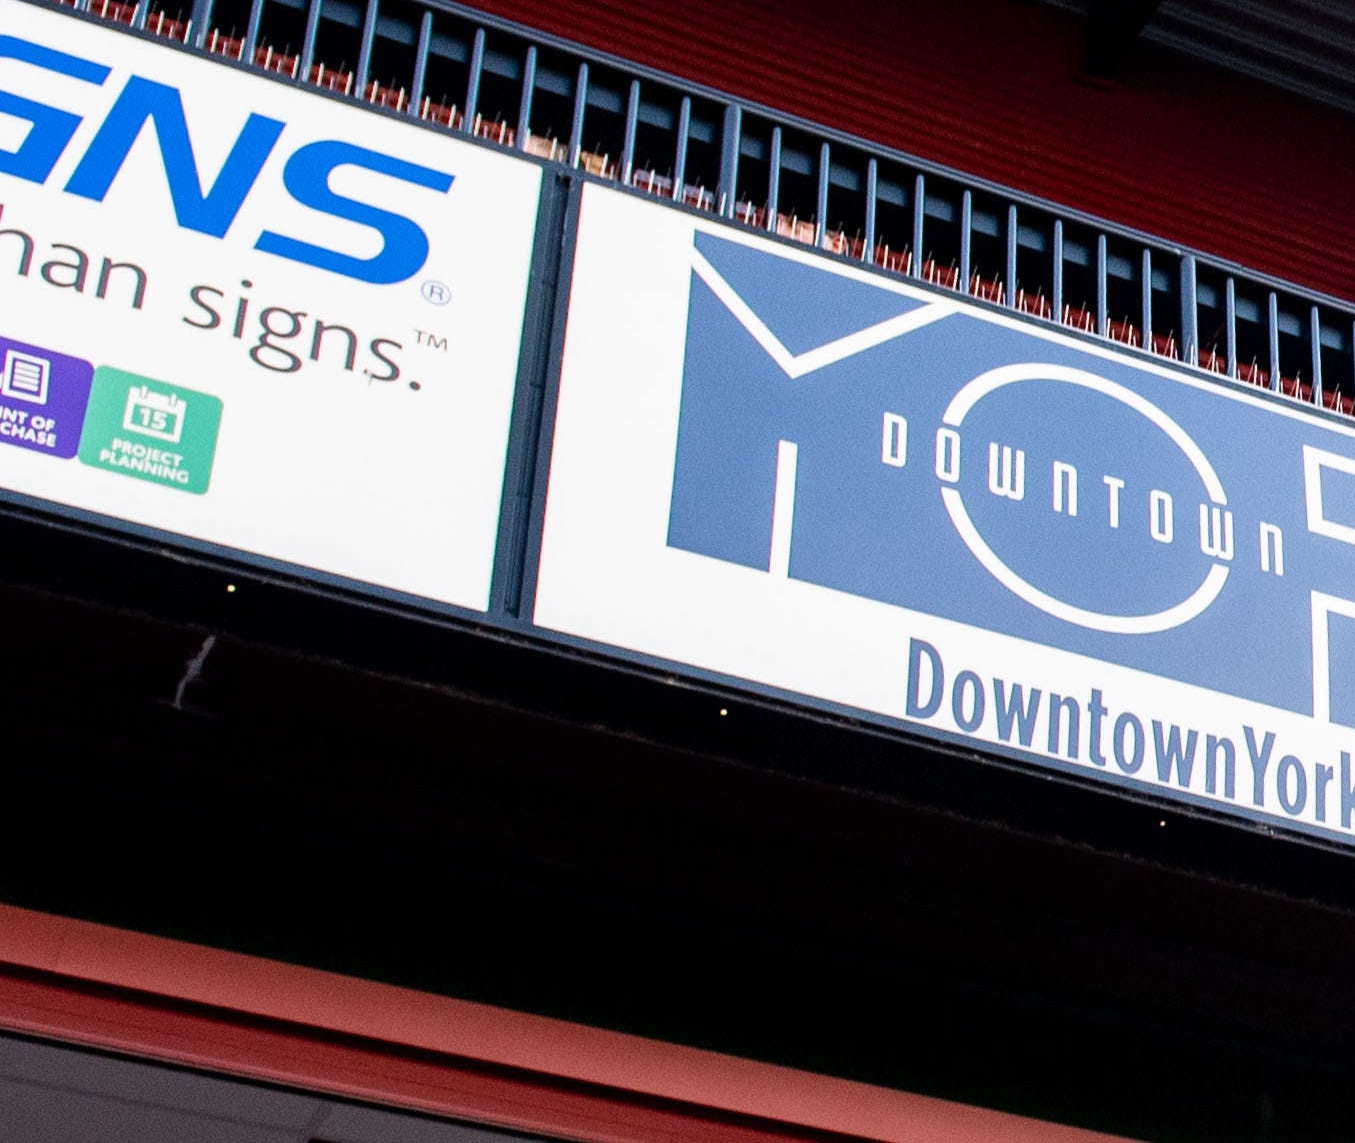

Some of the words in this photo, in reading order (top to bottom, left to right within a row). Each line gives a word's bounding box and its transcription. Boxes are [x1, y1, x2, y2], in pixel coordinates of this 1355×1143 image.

[31, 415, 56, 432] OF
[139, 408, 167, 430] 15
[99, 449, 189, 484] PLANNING
[112, 438, 183, 468] PROJECT
[881, 411, 1285, 577] DOWNTOWN
